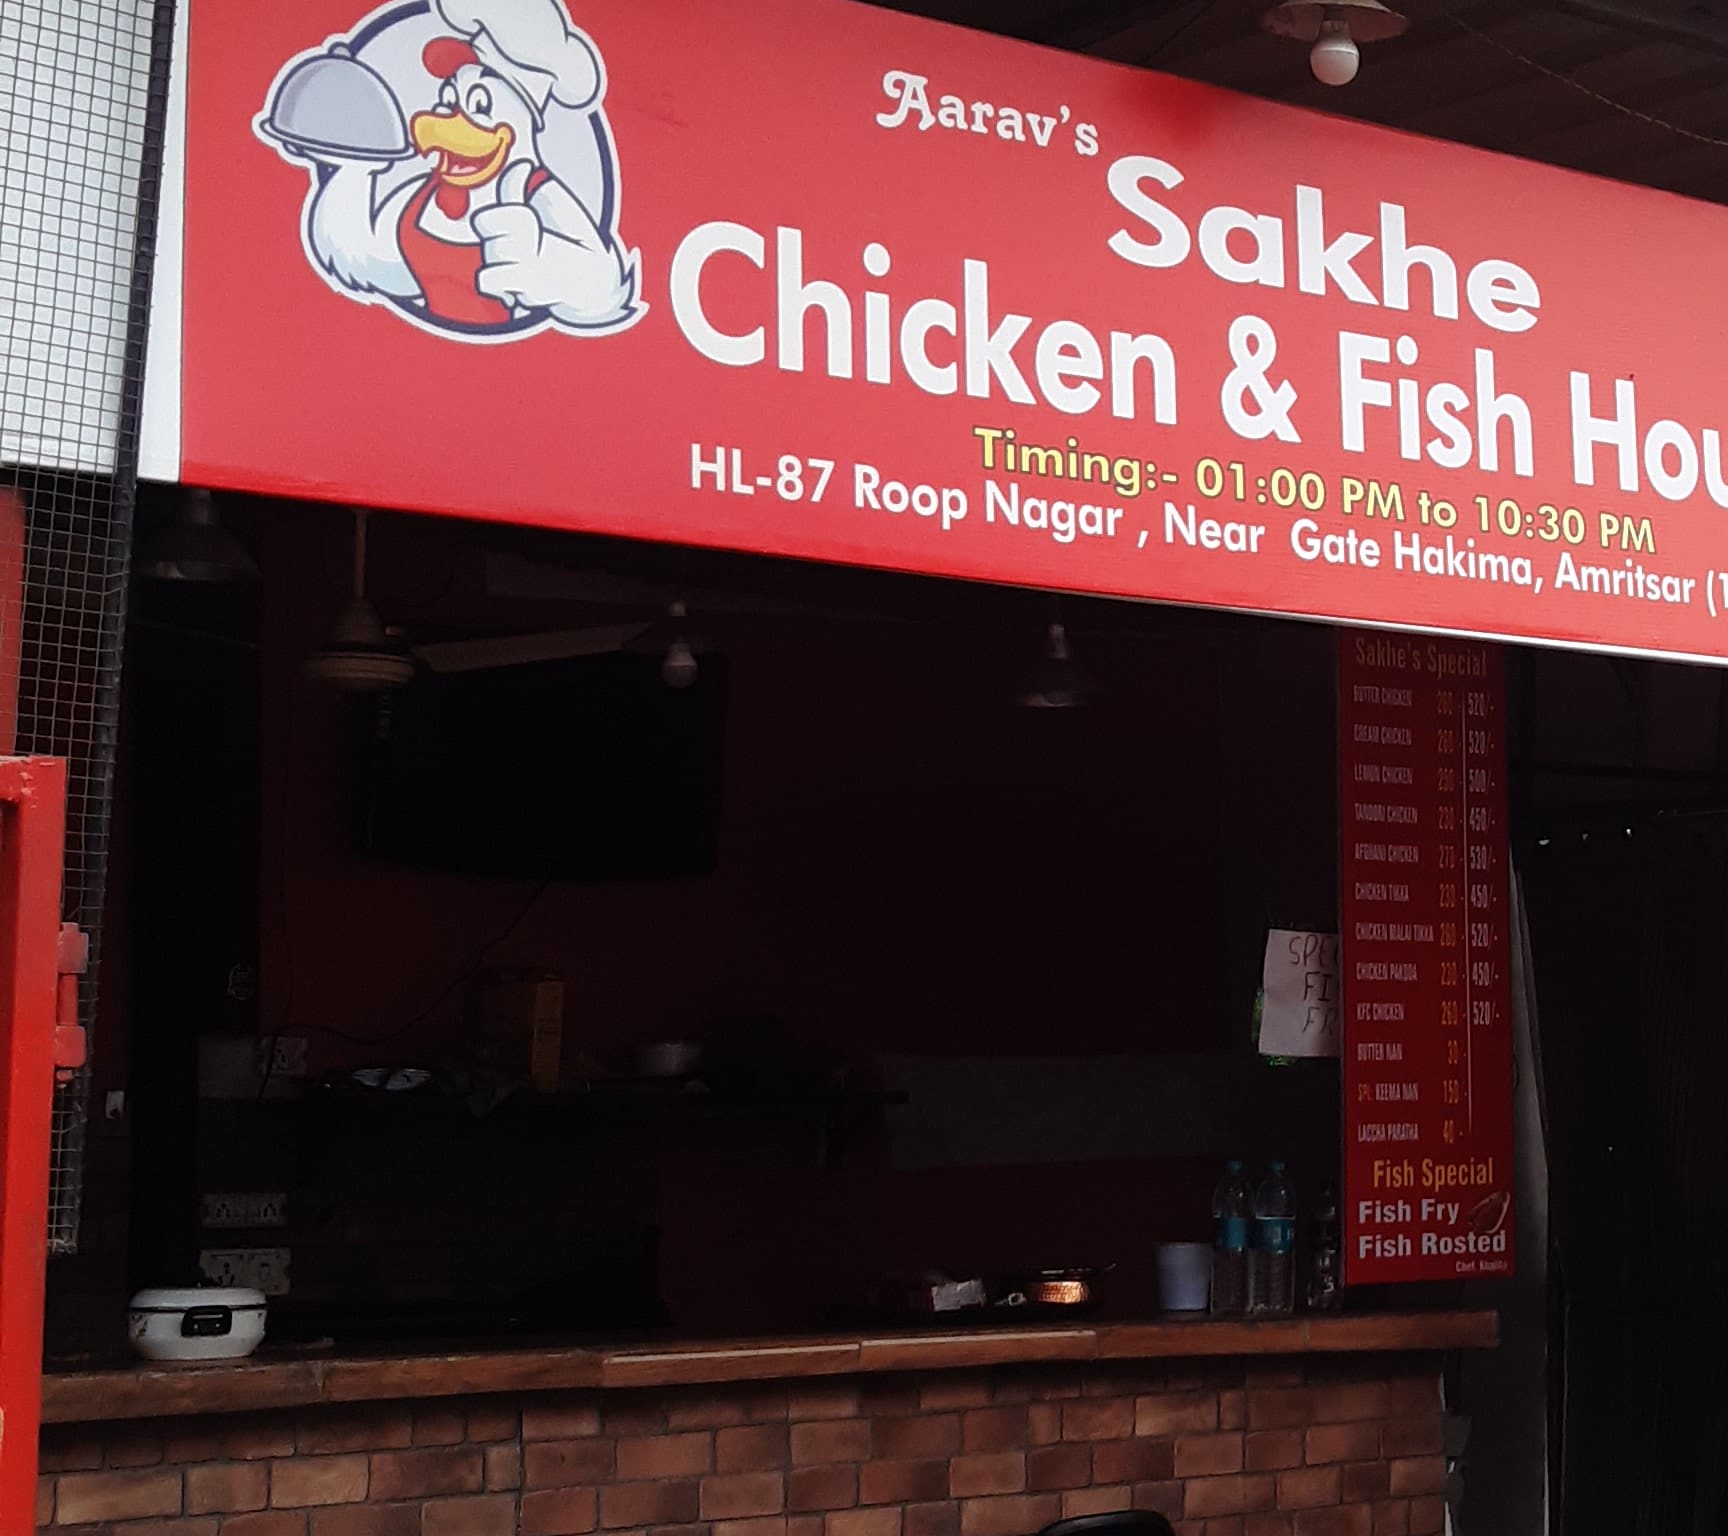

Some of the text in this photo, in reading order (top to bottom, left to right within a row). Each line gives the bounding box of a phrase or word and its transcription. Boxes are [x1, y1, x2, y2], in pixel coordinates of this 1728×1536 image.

[1107, 155, 1541, 333] Sakhe
[670, 221, 1177, 424] Chicken
[1220, 315, 1302, 444] &
[1338, 331, 1534, 475] Fish
[973, 427, 1655, 555] Timing:- 01:00 PM to 10:30 PM
[690, 444, 835, 502] HL-87
[855, 464, 967, 529] Roop
[984, 480, 1123, 542] Nagar
[1164, 502, 1264, 553] Near
[1290, 524, 1380, 567] Gate
[1394, 532, 1544, 594] Hakima,
[1555, 552, 1696, 605] Amritsar
[1355, 637, 1487, 679] Sakhe's Special
[1355, 882, 1387, 901] CHICKEN
[1355, 921, 1388, 941] CHICKEN
[1356, 961, 1388, 981] CHICKEN
[1372, 1002, 1405, 1021] CHICKEN
[1373, 1156, 1493, 1192] Fish Special
[1358, 1197, 1460, 1225] Fish Fry
[1358, 1229, 1507, 1259] Fish Rosted
